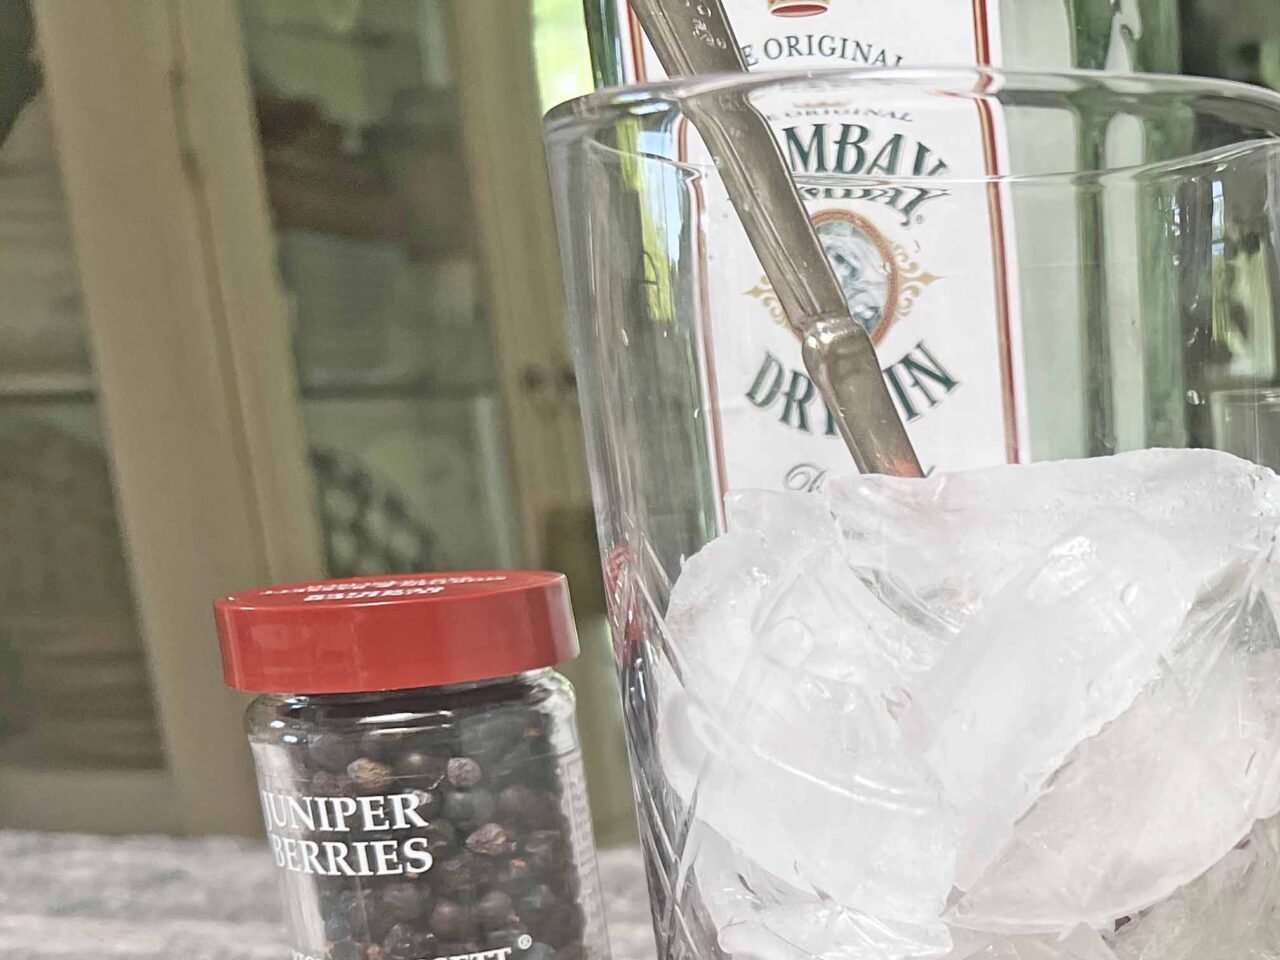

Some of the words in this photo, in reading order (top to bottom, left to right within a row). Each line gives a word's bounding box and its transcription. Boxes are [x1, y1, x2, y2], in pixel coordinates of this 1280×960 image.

[745, 350, 837, 437] DR
[882, 340, 962, 422] IN
[263, 790, 430, 832] JUNIPER
[270, 833, 434, 877] BERRIES
